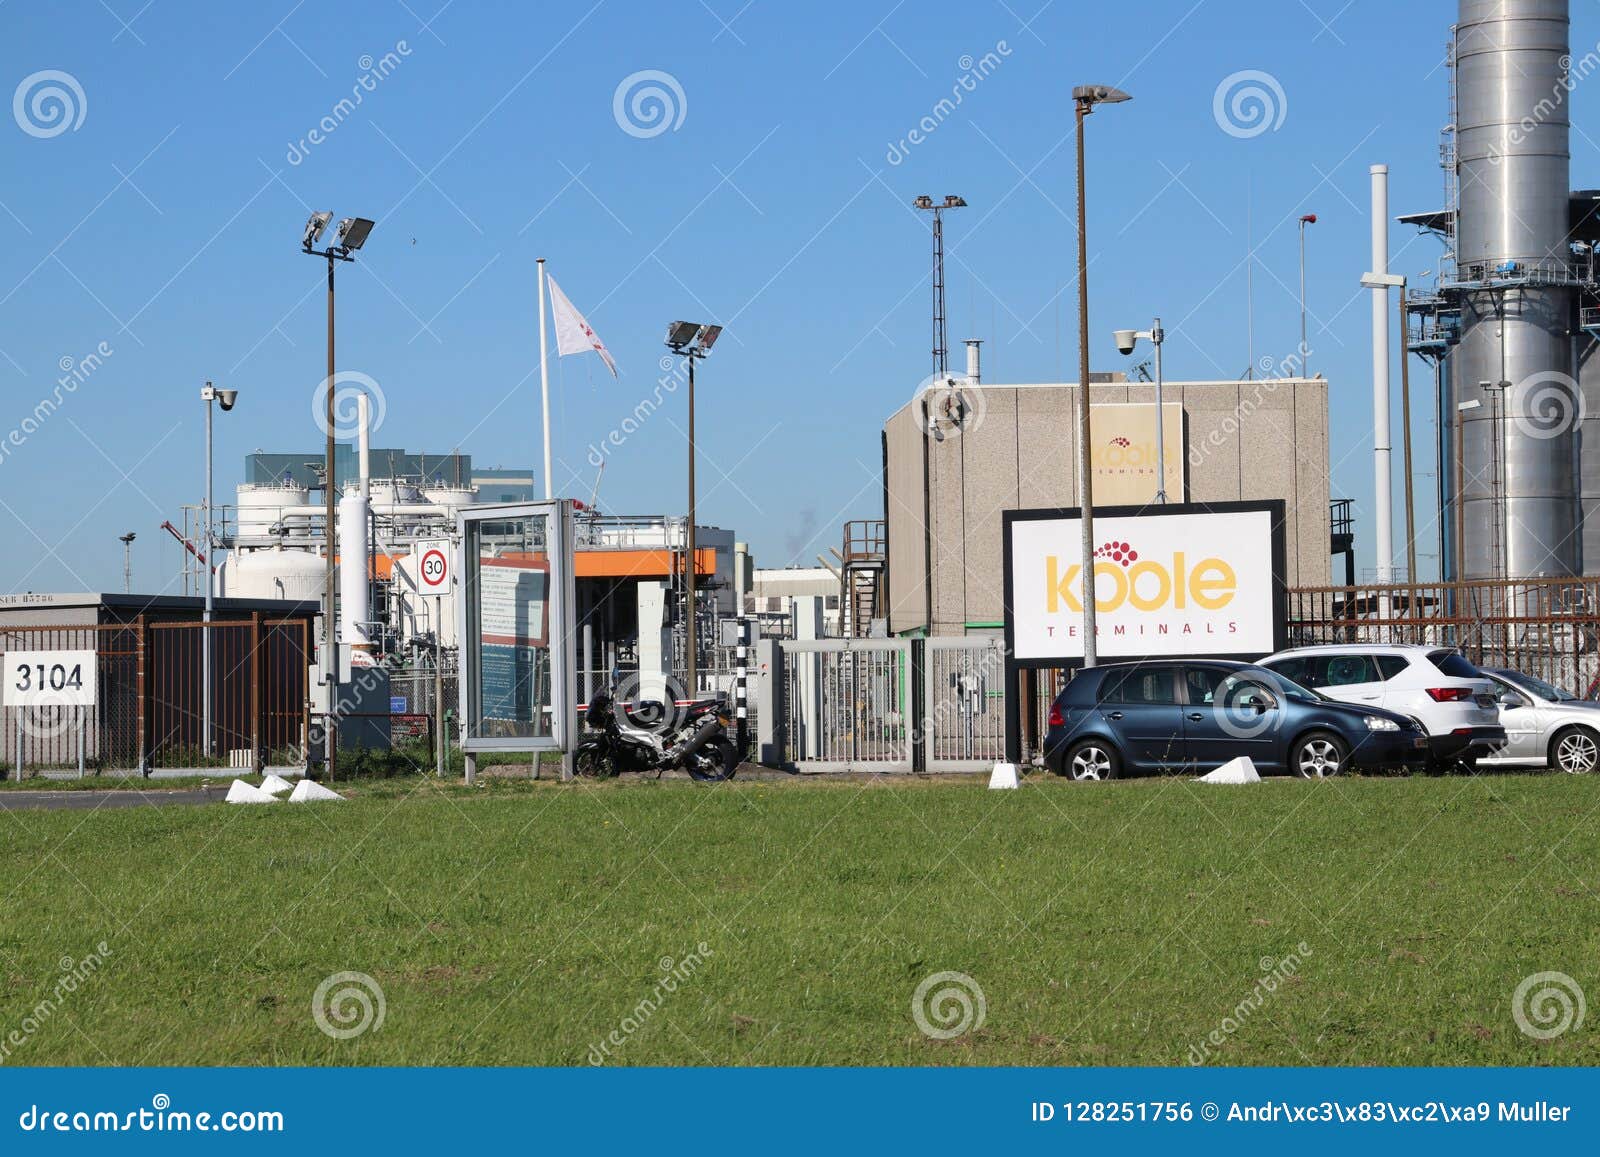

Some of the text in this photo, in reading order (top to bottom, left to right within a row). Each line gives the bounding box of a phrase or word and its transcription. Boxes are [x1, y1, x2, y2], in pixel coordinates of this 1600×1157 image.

[426, 561, 442, 574] 30
[1046, 552, 1237, 613] koole
[15, 663, 83, 691] 3104
